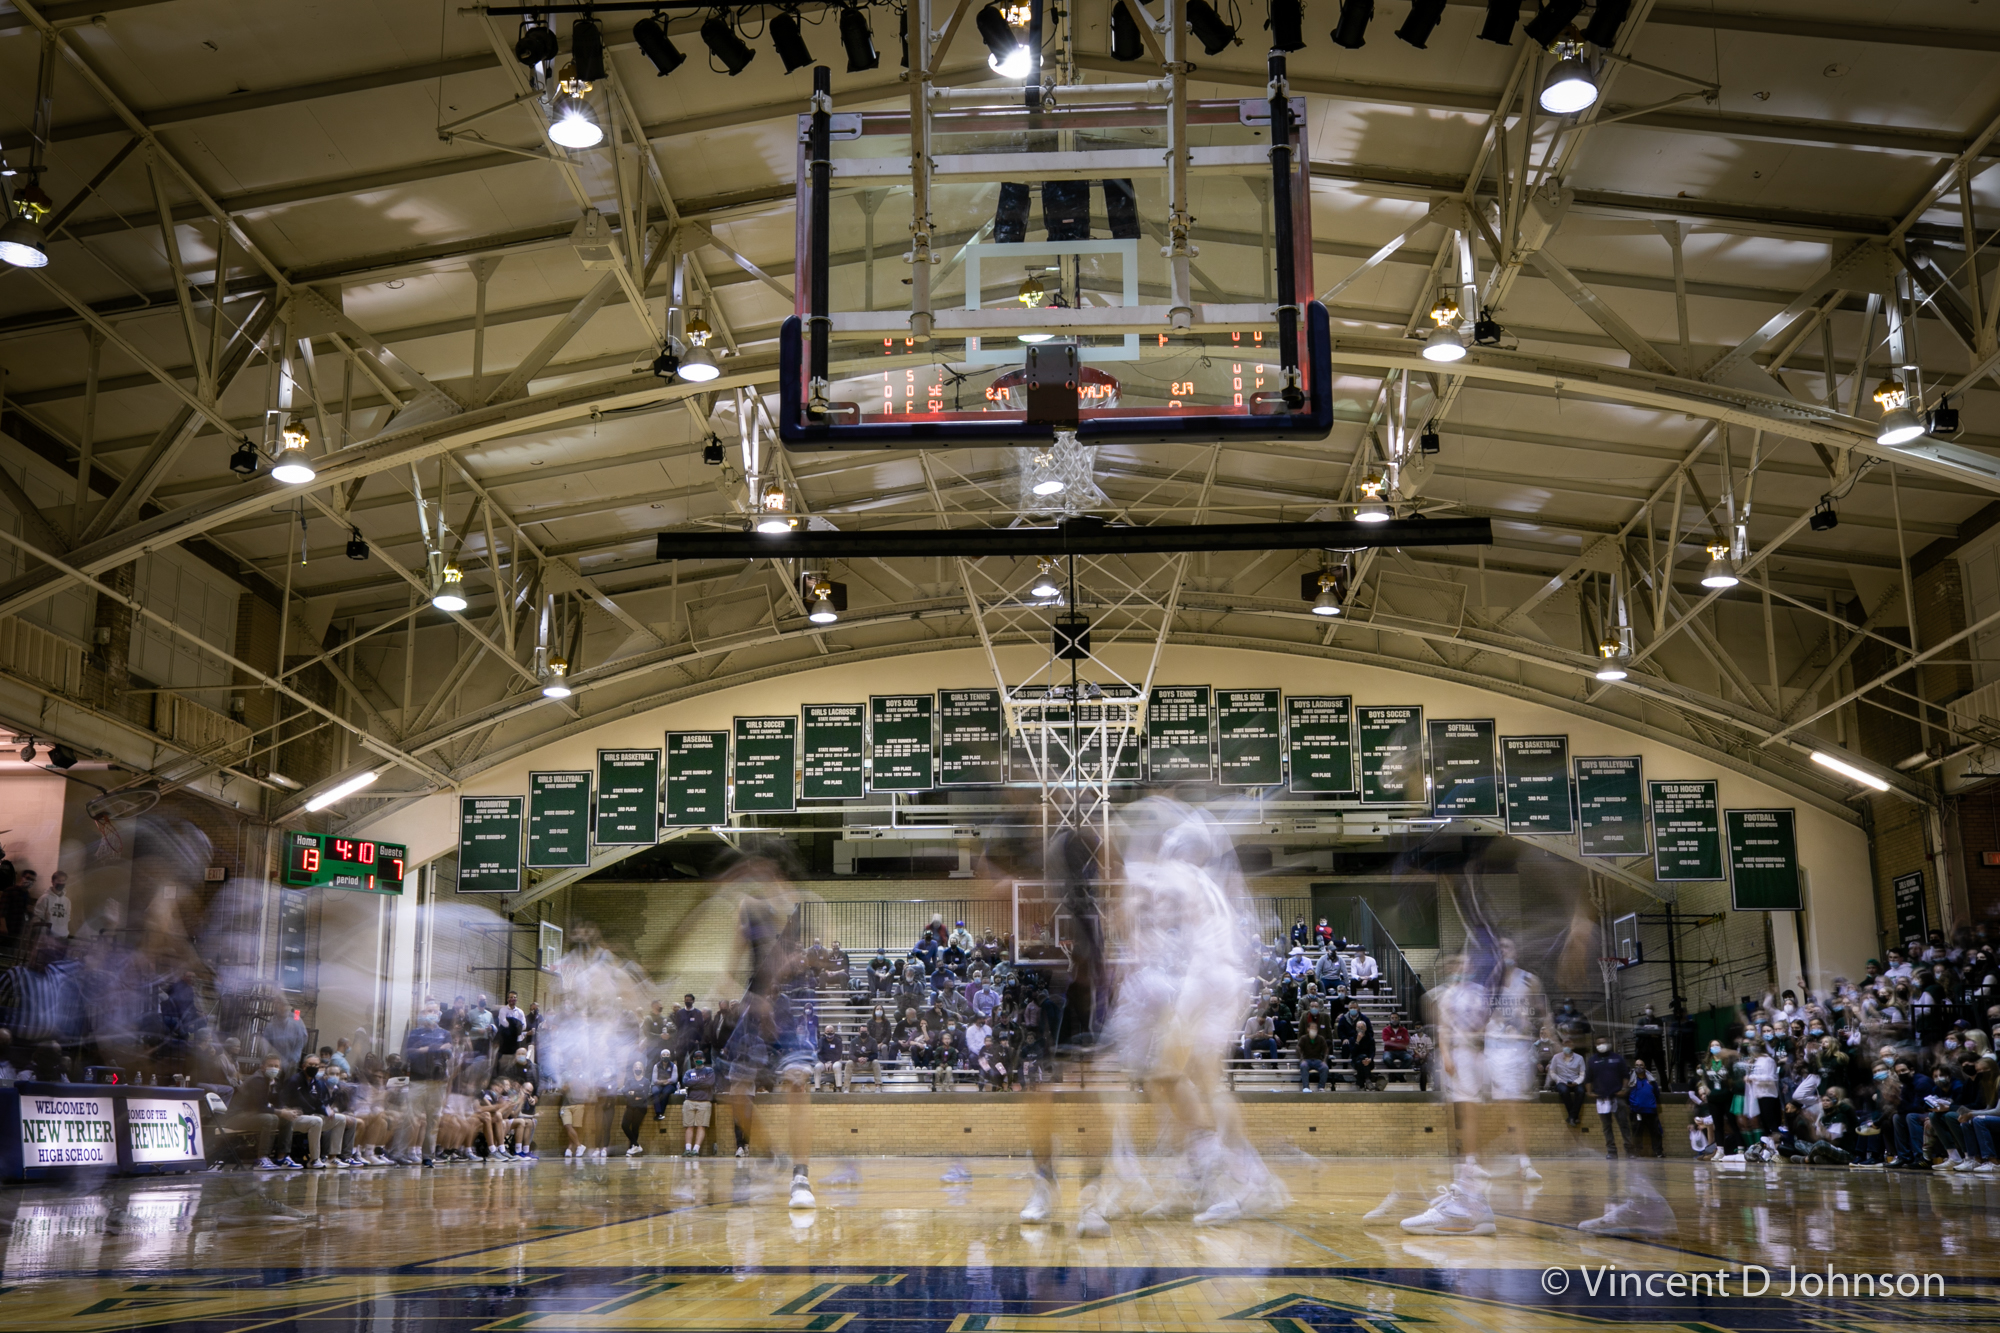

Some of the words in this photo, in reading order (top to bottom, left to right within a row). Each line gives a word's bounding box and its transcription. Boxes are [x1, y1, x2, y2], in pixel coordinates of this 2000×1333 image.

[1176, 690, 1197, 698] TENNIS
[621, 753, 654, 761] BASKETBALL
[1680, 785, 1705, 793] HOCKEY
[297, 835, 317, 846] Home
[336, 840, 374, 864] 4:10
[380, 846, 403, 857] Guests
[303, 849, 319, 871] 13
[393, 859, 403, 880] 7
[336, 876, 358, 885] period
[369, 875, 374, 889] 1
[35, 1101, 85, 1114] WELCOME
[86, 1103, 98, 1115] TO
[147, 1110, 153, 1119] OF
[155, 1110, 167, 1119] THE
[23, 1119, 63, 1143] NEW
[64, 1120, 114, 1143] TRIER
[38, 1149, 64, 1162] HIGH
[66, 1148, 103, 1162] SCHOOL
